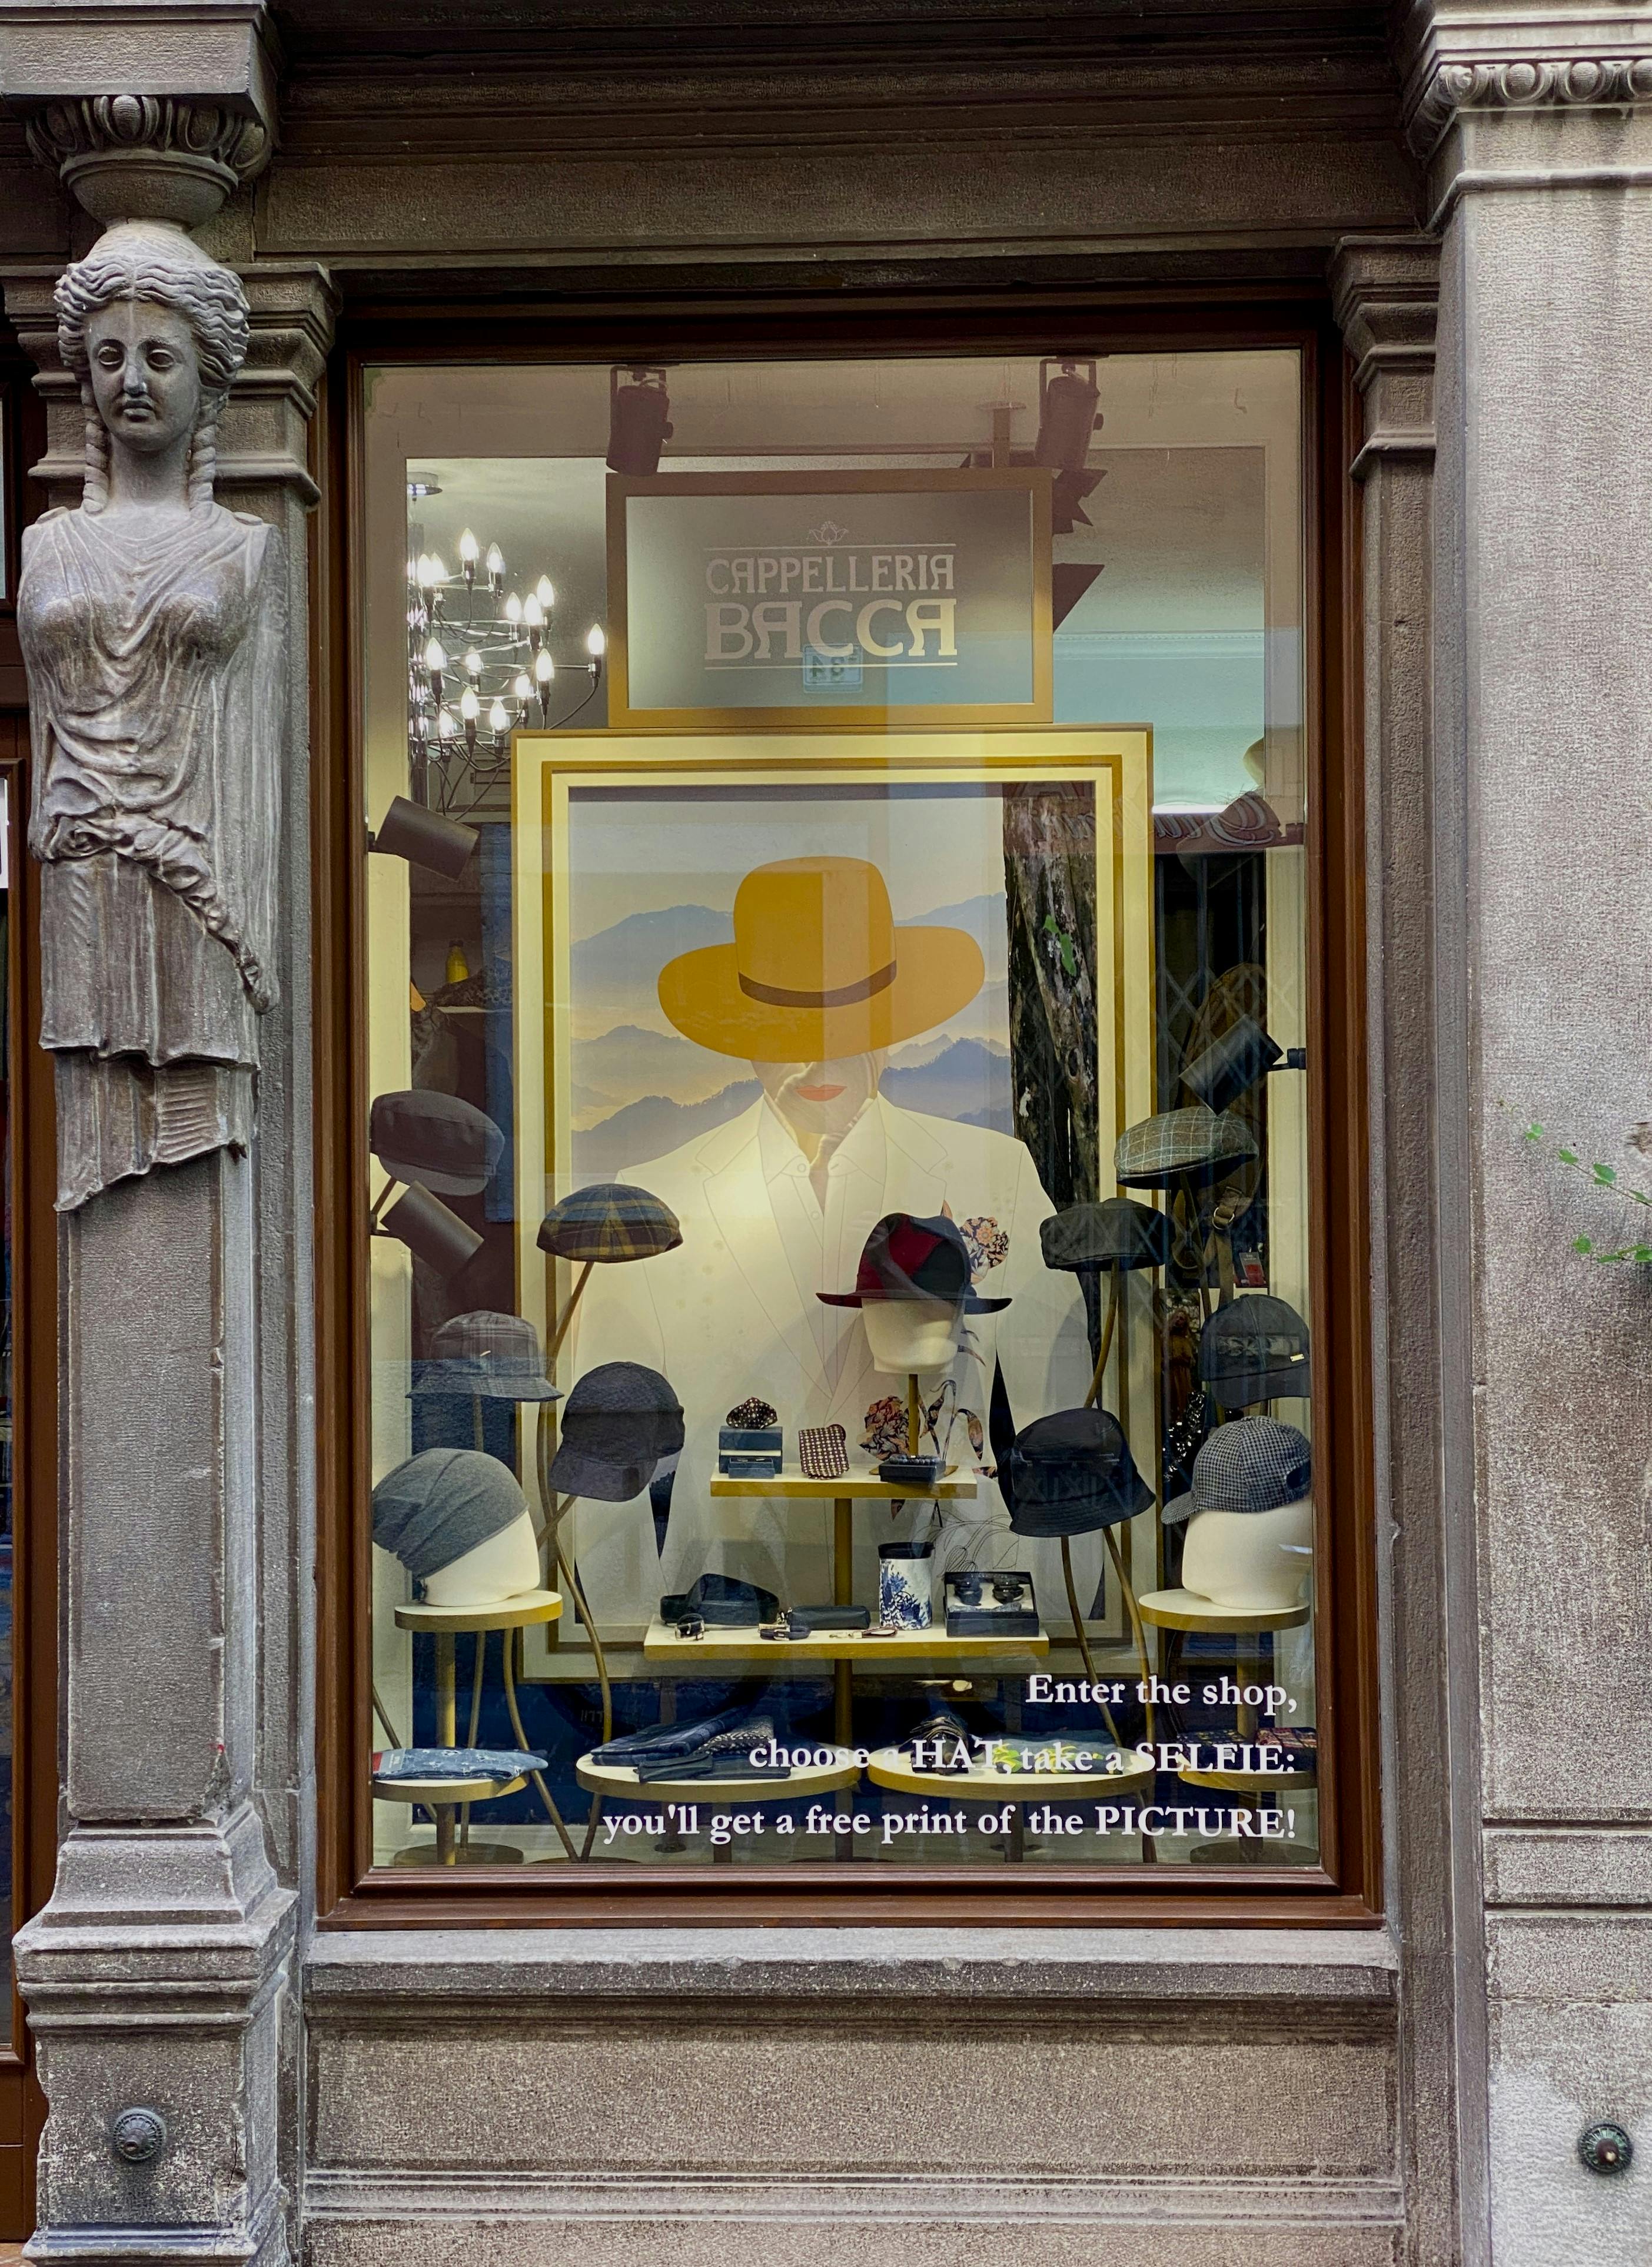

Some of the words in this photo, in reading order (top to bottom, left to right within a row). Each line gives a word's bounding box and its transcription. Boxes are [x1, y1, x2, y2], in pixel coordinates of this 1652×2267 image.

[707, 553, 955, 594] CAPPELLERIA
[704, 598, 958, 660] BACCA
[1025, 1674, 1125, 1704] Enter
[1136, 1675, 1190, 1704] the
[1203, 1676, 1297, 1716] shop,
[749, 1738, 870, 1768] choose
[882, 1748, 899, 1767] a
[912, 1739, 1013, 1775] HAT,
[1020, 1742, 1093, 1771] take
[1105, 1752, 1124, 1771] a
[1136, 1742, 1295, 1774] SELFIE:
[603, 1804, 700, 1844] you'll
[710, 1811, 764, 1845] get
[776, 1815, 795, 1834] a
[806, 1805, 870, 1834] free
[882, 1805, 967, 1844] print
[978, 1805, 1016, 1834] of
[1029, 1805, 1083, 1835] the
[1095, 1806, 1295, 1838] PICTURE!
